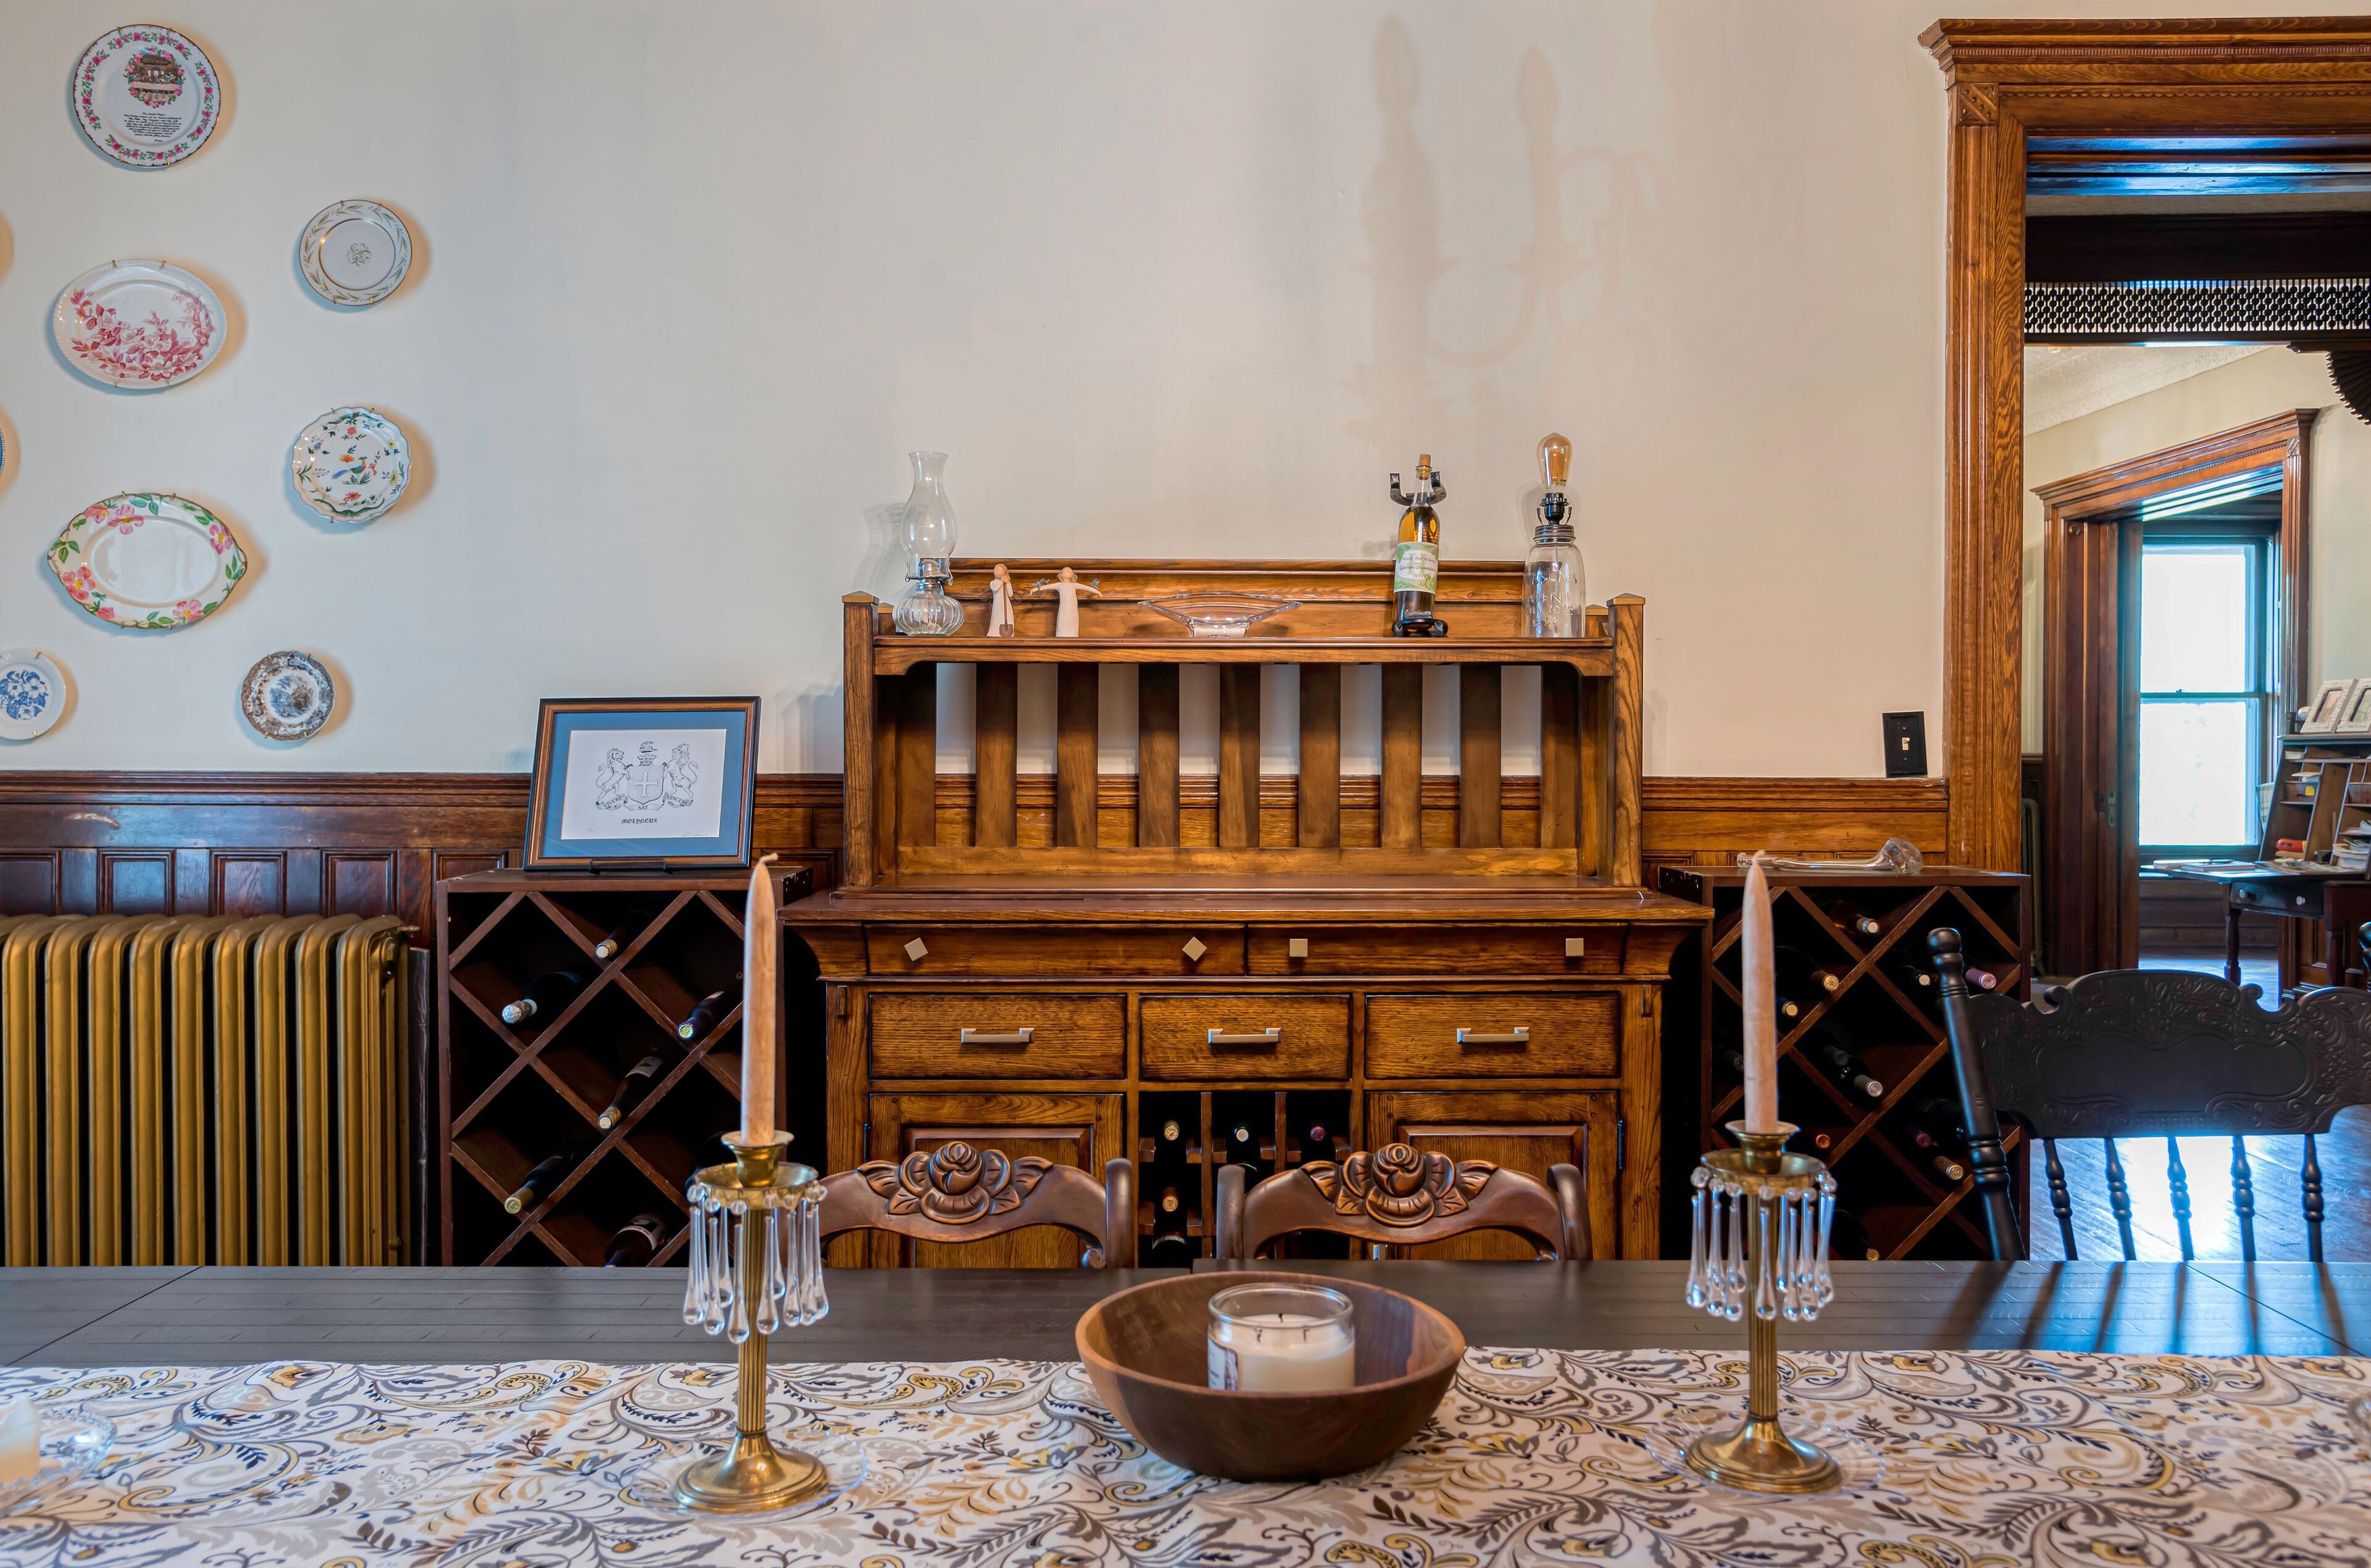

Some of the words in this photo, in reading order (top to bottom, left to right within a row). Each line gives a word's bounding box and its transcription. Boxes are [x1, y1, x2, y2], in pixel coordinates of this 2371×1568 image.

[1526, 591, 1571, 604] ATENT
[602, 795, 623, 808] VIVERE
[666, 794, 689, 806] VINCERE
